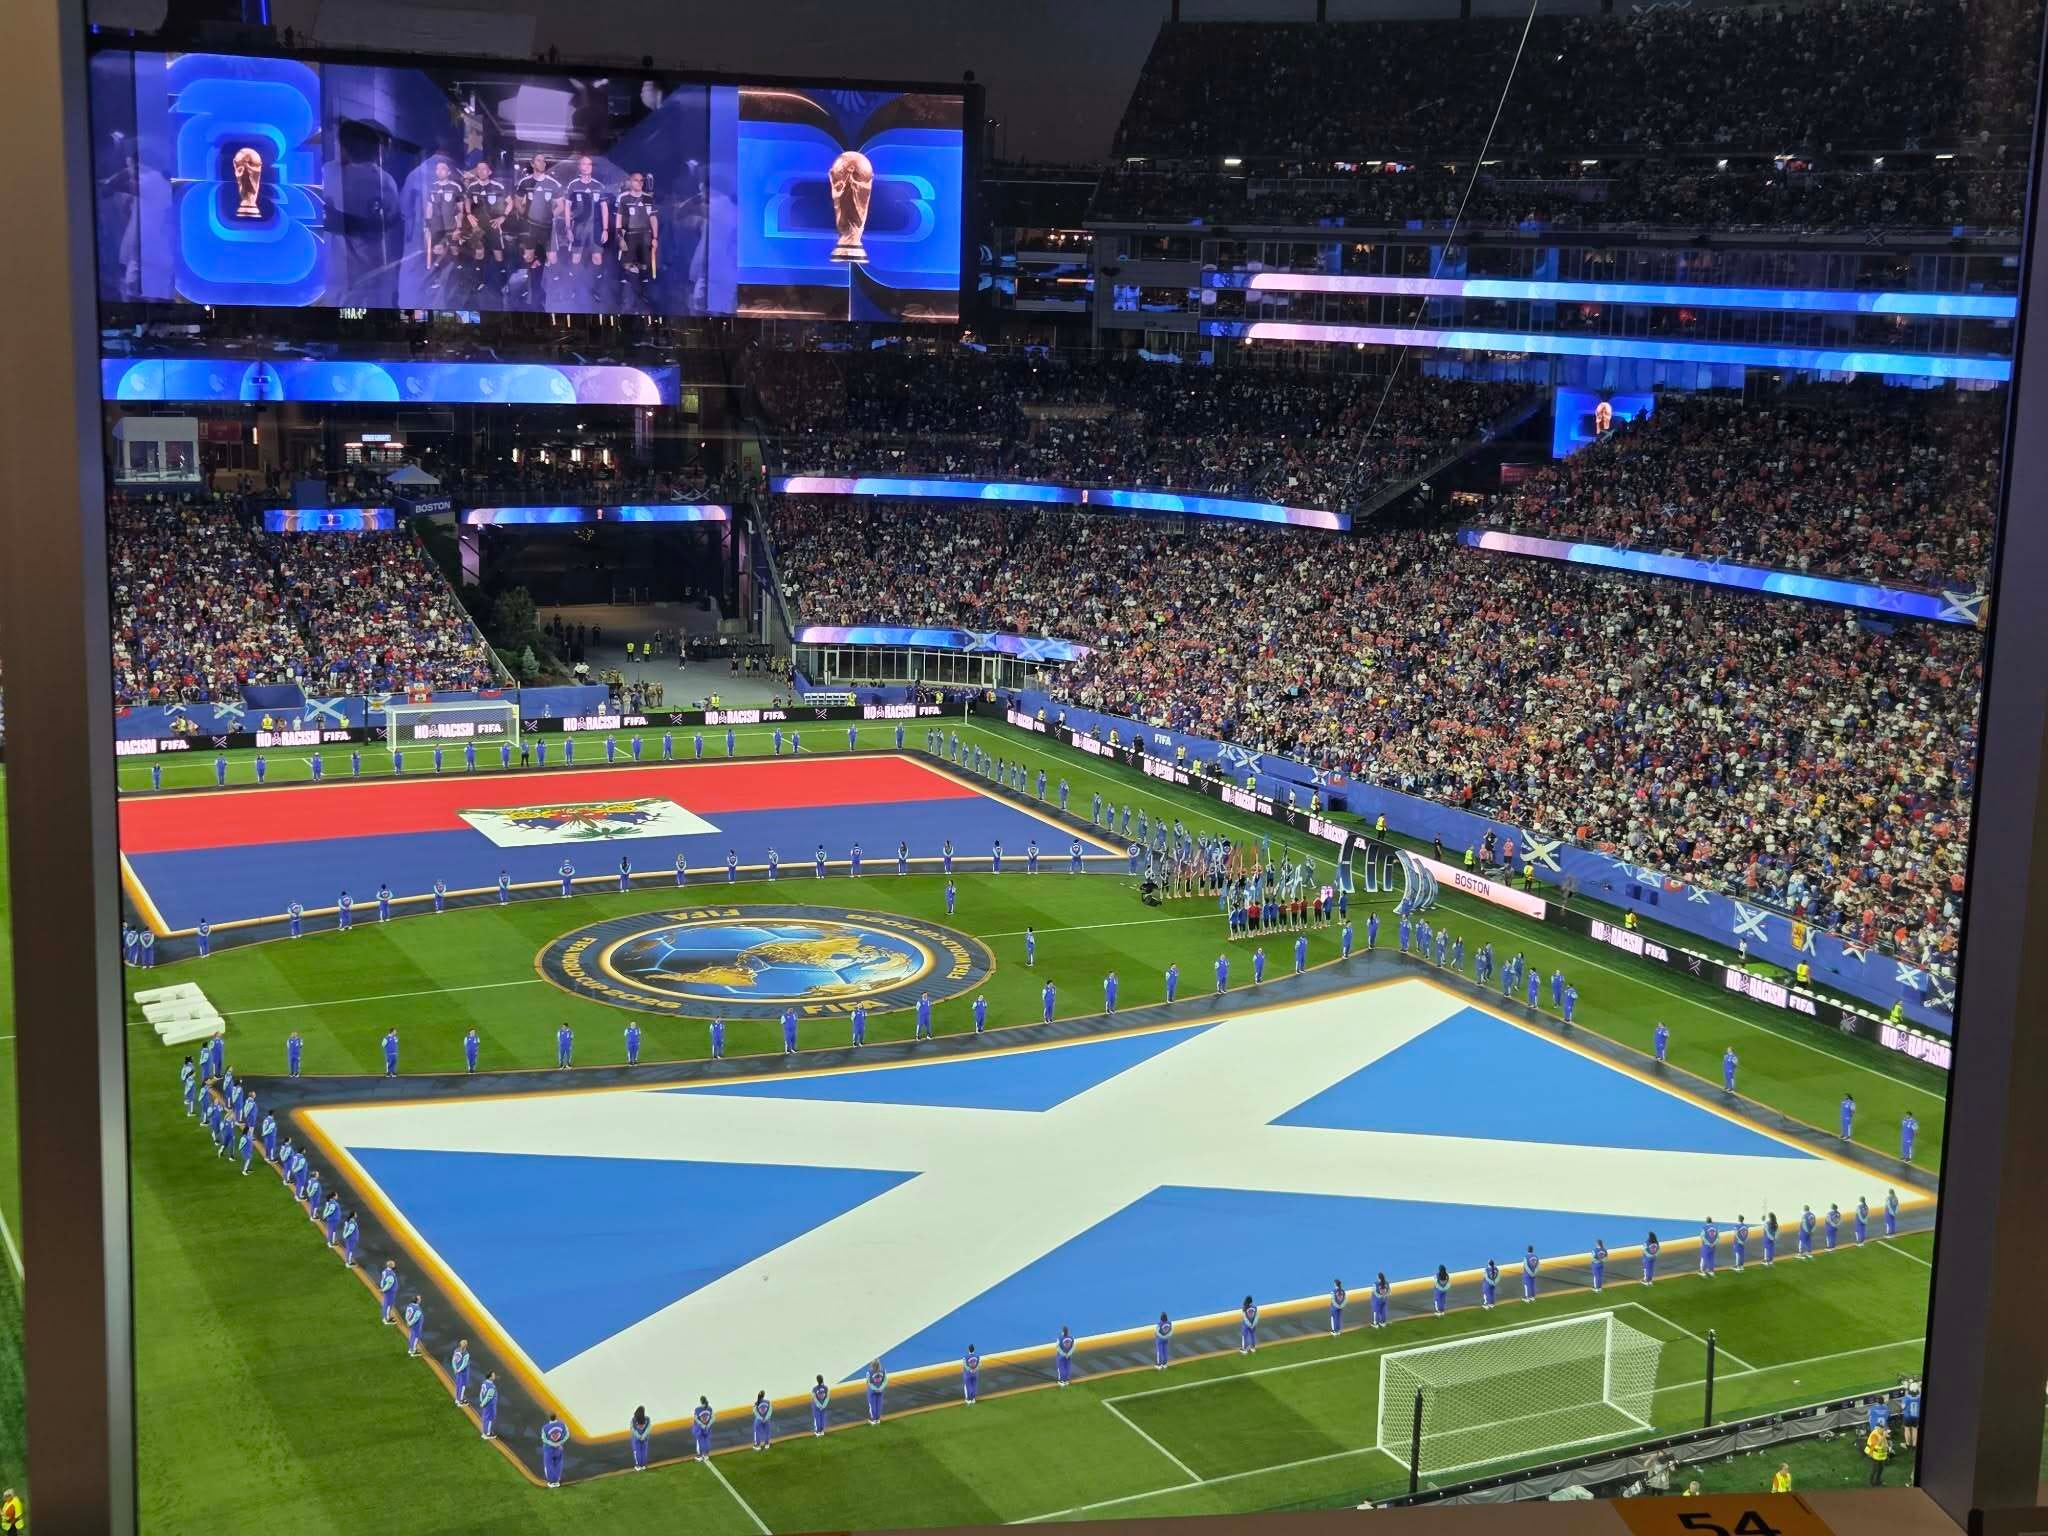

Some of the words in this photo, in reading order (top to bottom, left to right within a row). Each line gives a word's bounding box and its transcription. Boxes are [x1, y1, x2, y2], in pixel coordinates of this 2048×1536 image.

[415, 501, 451, 514] BOSTON
[705, 712, 719, 724] NO
[727, 710, 760, 724] RACISM
[763, 711, 786, 720] FIFA
[864, 706, 876, 719] NO
[885, 705, 916, 718] RACISM
[920, 706, 941, 715] FIFA
[415, 725, 429, 739] NO
[438, 723, 474, 737] RACISM
[478, 724, 501, 733] FIFA
[563, 718, 577, 731] NO
[586, 716, 621, 730] RACISM
[624, 717, 647, 725] FIFA
[116, 739, 157, 755] RACISM
[161, 740, 187, 750] FIFA
[256, 732, 272, 747] NO
[282, 731, 319, 746] RACISM
[324, 732, 349, 741] FIFA
[1154, 733, 1172, 747] FIFA
[1455, 873, 1490, 897] BOSTON
[662, 907, 740, 920] FIFA
[566, 937, 598, 953] FIFA
[914, 929, 946, 946] CUP
[1591, 920, 1606, 942] NO
[1611, 927, 1644, 956] RACISM
[1645, 942, 1668, 962] FIFA
[941, 940, 972, 967] WORLD
[561, 952, 586, 977] WORLD
[576, 976, 609, 991] CUP
[601, 989, 682, 1009] 2026
[1726, 969, 1743, 992] NO
[1750, 977, 1787, 1009] RACISM
[1789, 994, 1816, 1016] FIFA
[802, 999, 891, 1015] FIFA
[1881, 1024, 1899, 1050] NO
[1908, 1034, 1952, 1070] RACISM
[1677, 1510, 1782, 1536] 54
